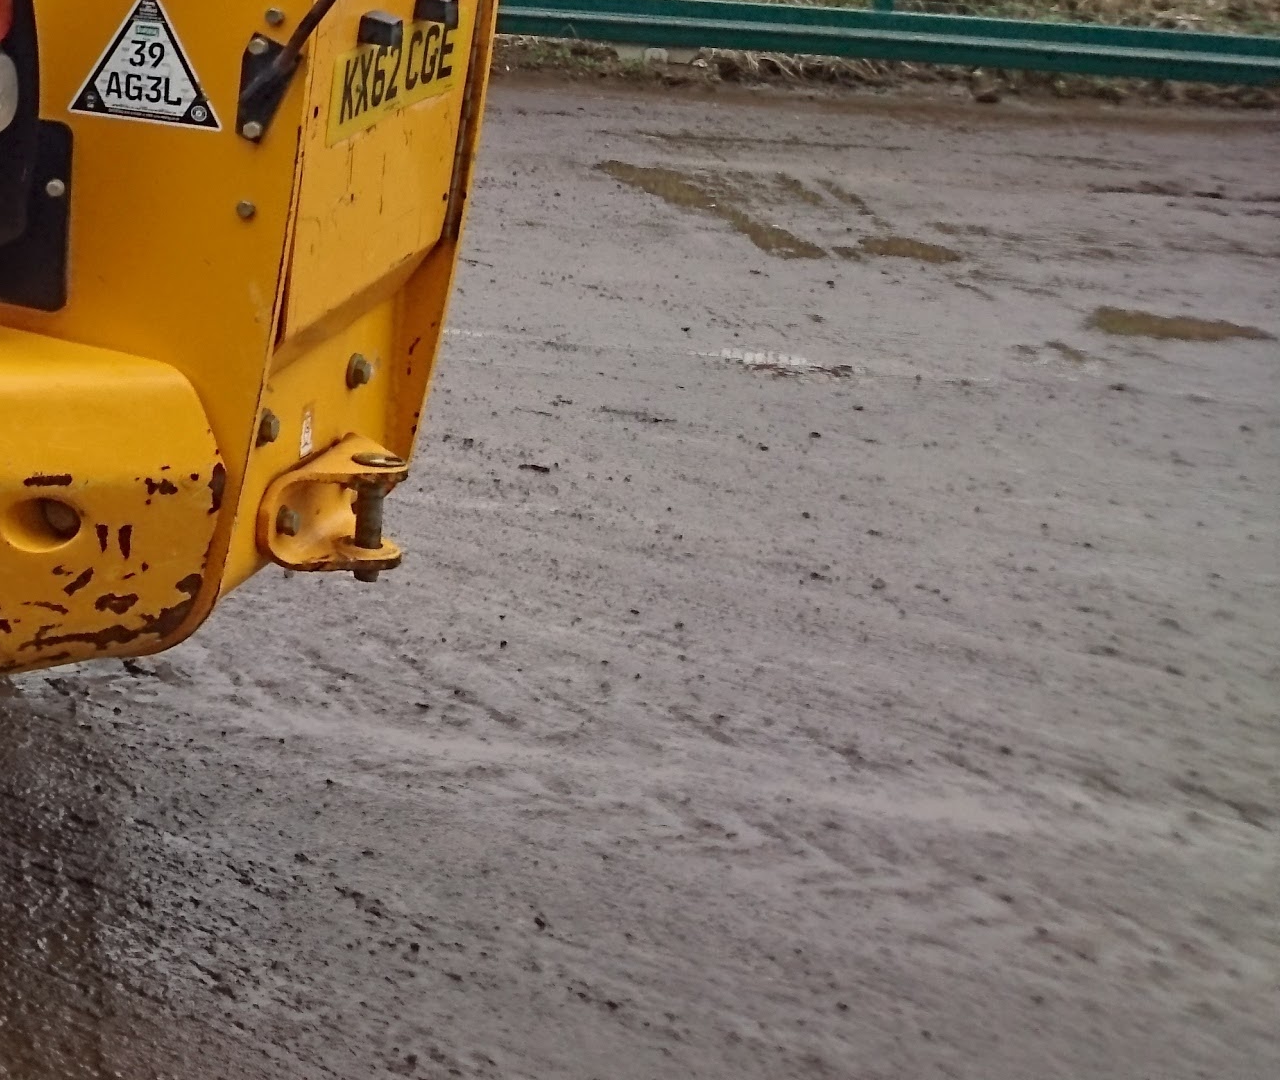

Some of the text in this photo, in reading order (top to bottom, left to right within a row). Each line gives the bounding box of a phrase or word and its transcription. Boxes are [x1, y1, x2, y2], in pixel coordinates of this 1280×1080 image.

[129, 39, 166, 69] 39
[105, 71, 182, 107] AG3L
[338, 23, 454, 126] KX62 CGE
